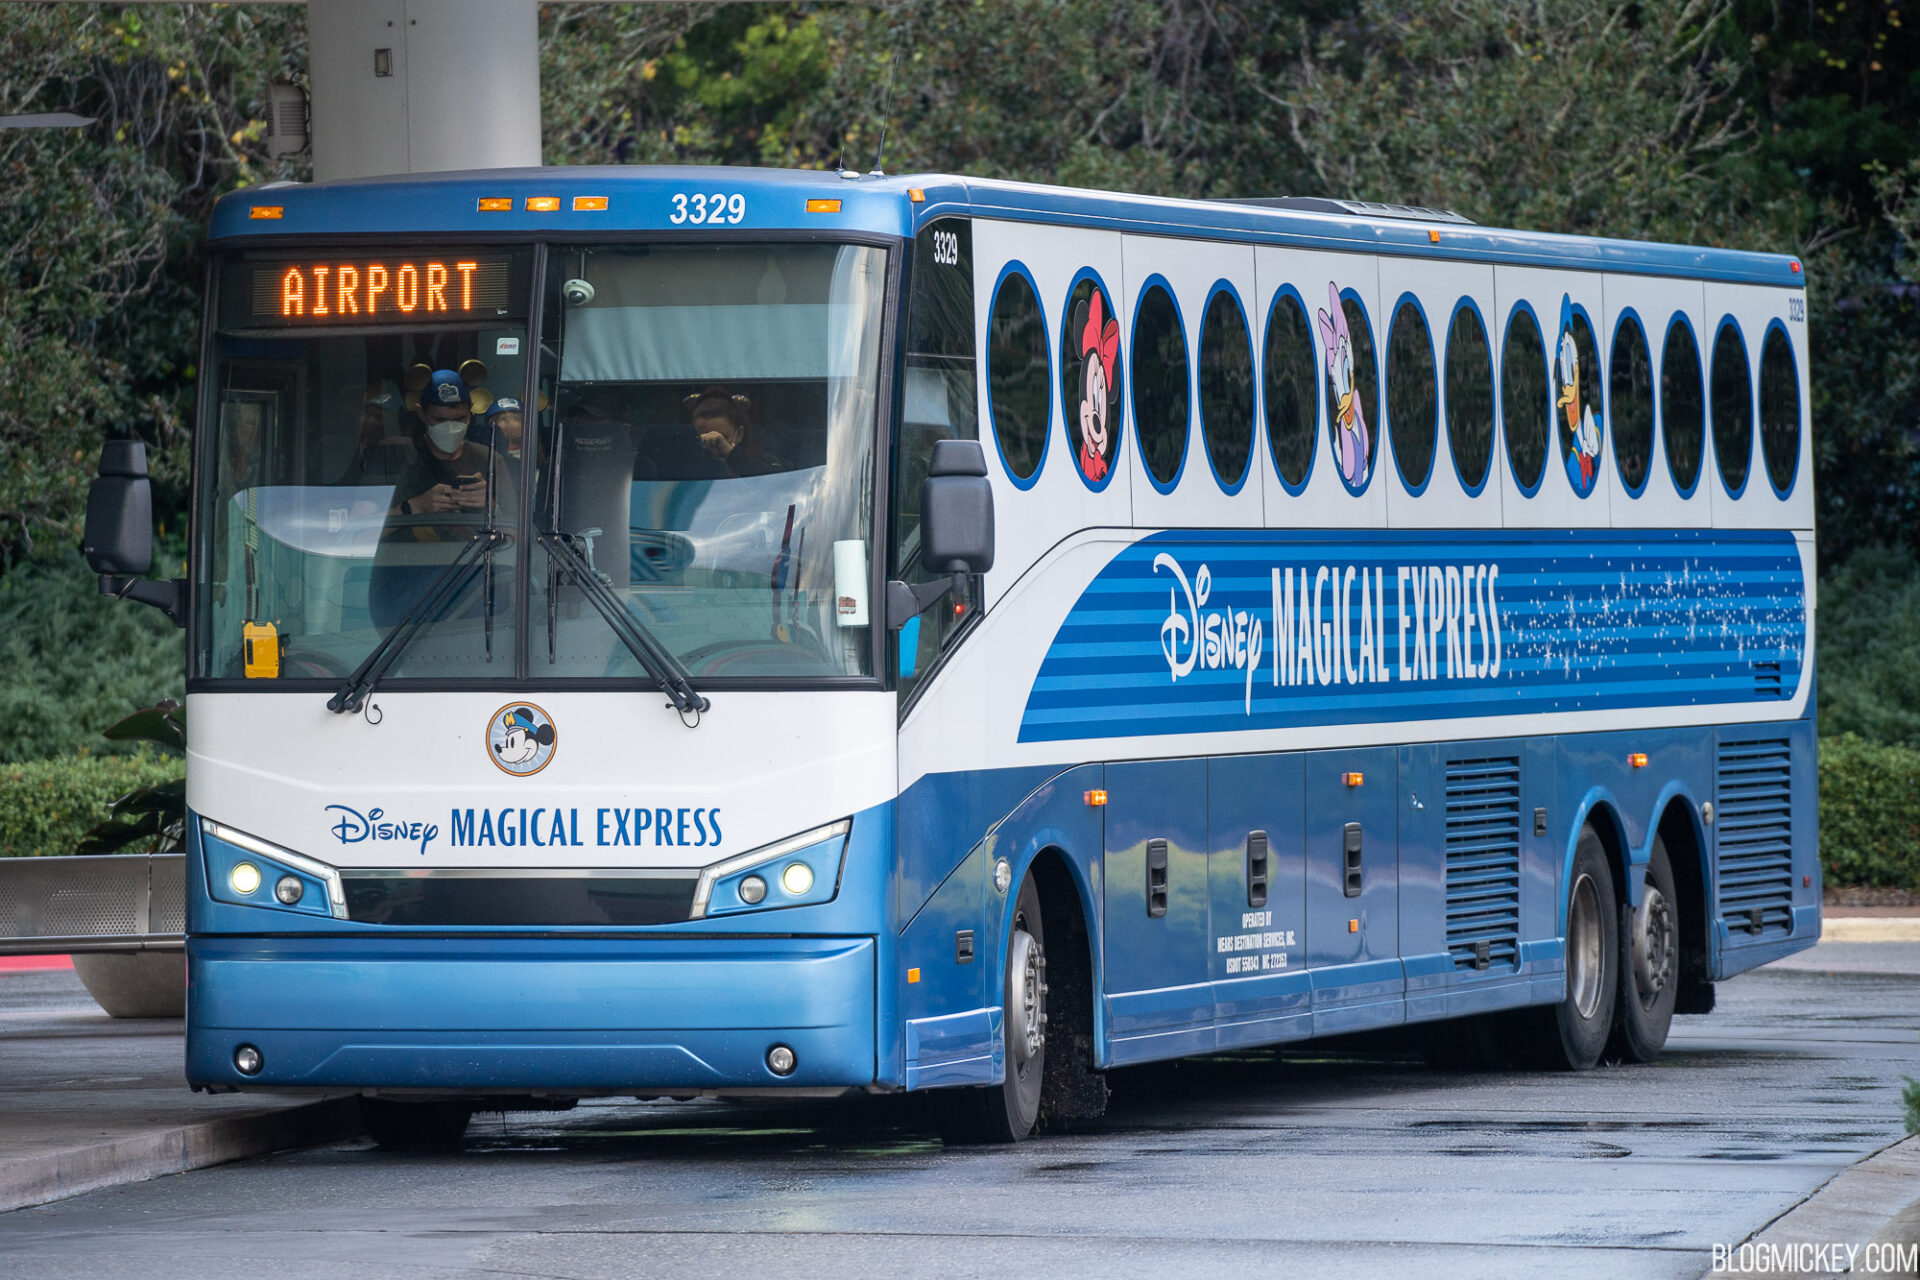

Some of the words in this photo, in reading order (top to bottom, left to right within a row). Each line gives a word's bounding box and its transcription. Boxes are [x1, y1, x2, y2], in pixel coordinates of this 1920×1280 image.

[669, 193, 746, 225] 3329
[933, 230, 958, 266] 3329
[283, 261, 477, 316] AIRPORT
[1789, 297, 1804, 322] 3329
[1271, 565, 1390, 687] MAGICAL
[1397, 563, 1501, 681] EXPRESS
[451, 807, 584, 847] MAGICAL
[596, 807, 722, 847] EXPRESS
[1242, 911, 1265, 929] OPERATED
[1265, 910, 1272, 927] BY
[1217, 936, 1234, 953] MEARS
[1234, 933, 1263, 951] DESTINATION
